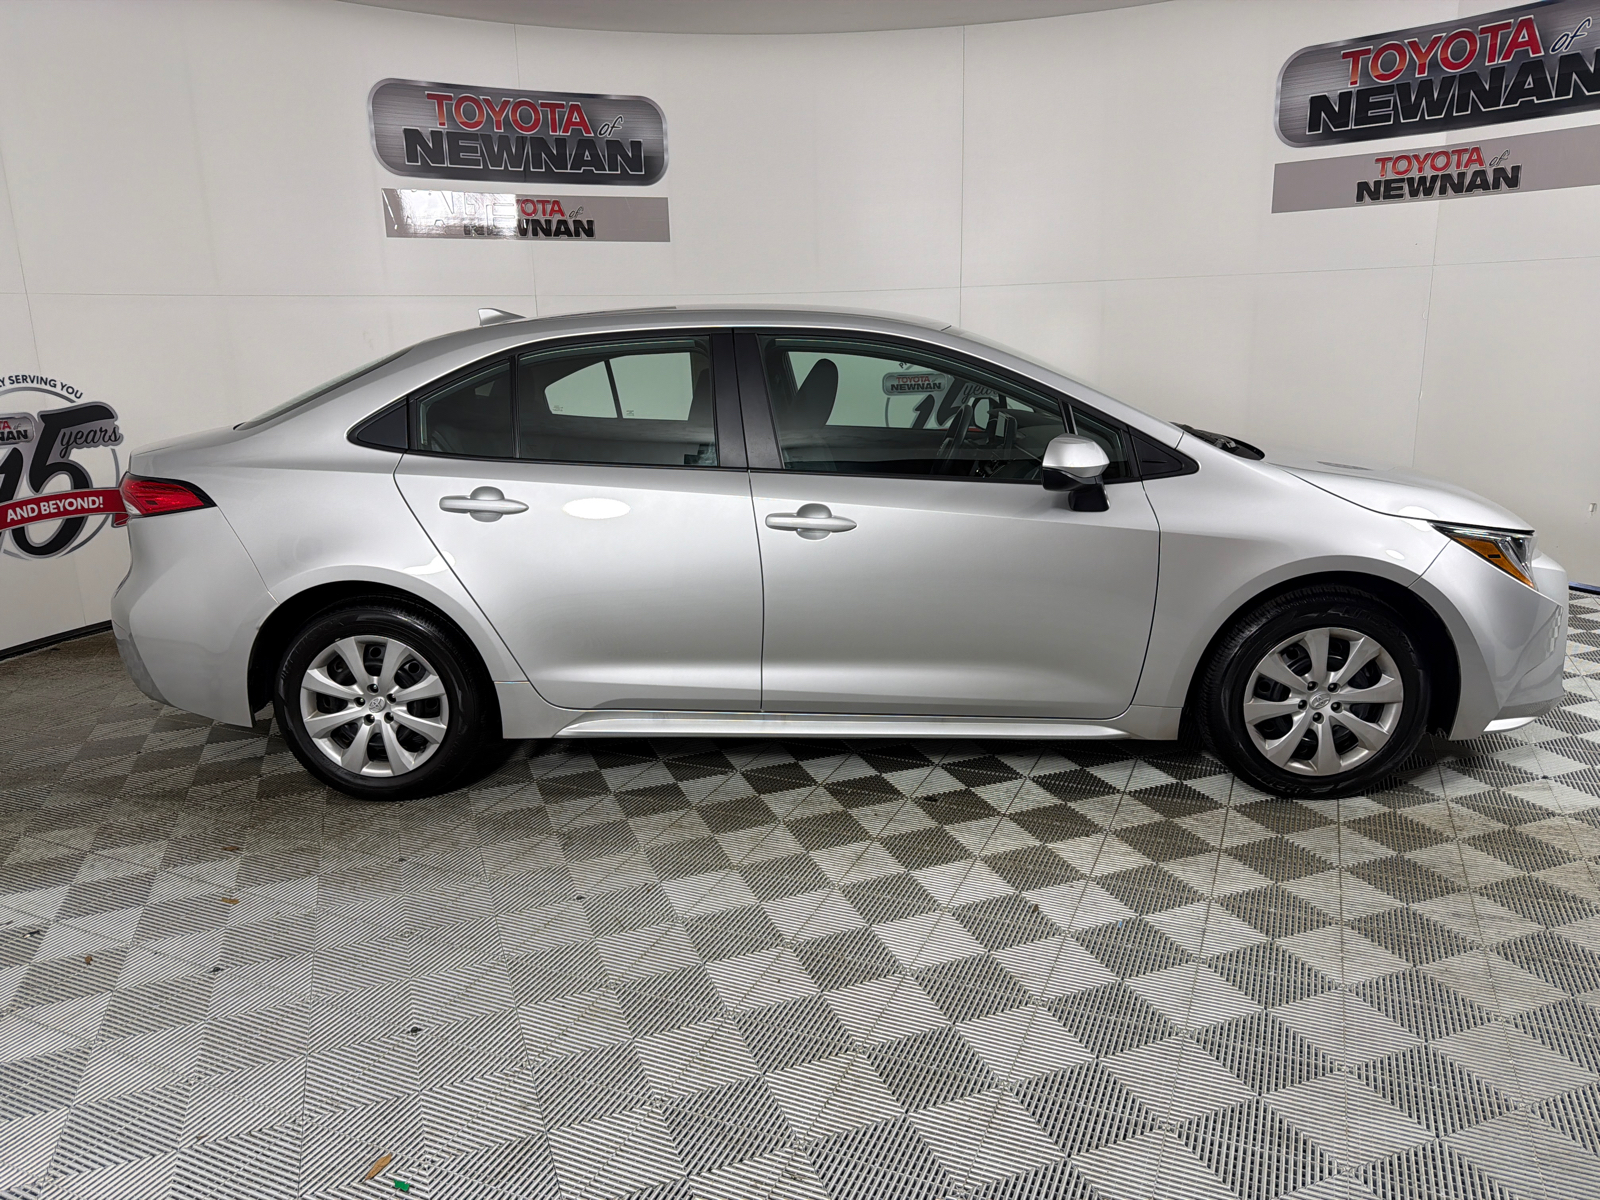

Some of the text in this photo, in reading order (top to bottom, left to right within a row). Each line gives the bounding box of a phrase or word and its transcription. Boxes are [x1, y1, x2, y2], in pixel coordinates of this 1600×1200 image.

[1341, 15, 1592, 87] TOYOTA of
[1305, 47, 1600, 135] NEWNAN
[425, 91, 624, 138] TOYOTA of
[402, 127, 645, 174] NEWNAN
[1374, 146, 1511, 177] TOYOTA of
[1355, 164, 1522, 204] NEWNAN
[569, 206, 584, 219] of
[8, 374, 57, 388] SERVING
[60, 382, 83, 400] YOU
[890, 382, 942, 391] NEWNAN
[896, 375, 931, 384] TOYOTA
[59, 425, 120, 459] years
[6, 496, 104, 523] AND BEYOND!
